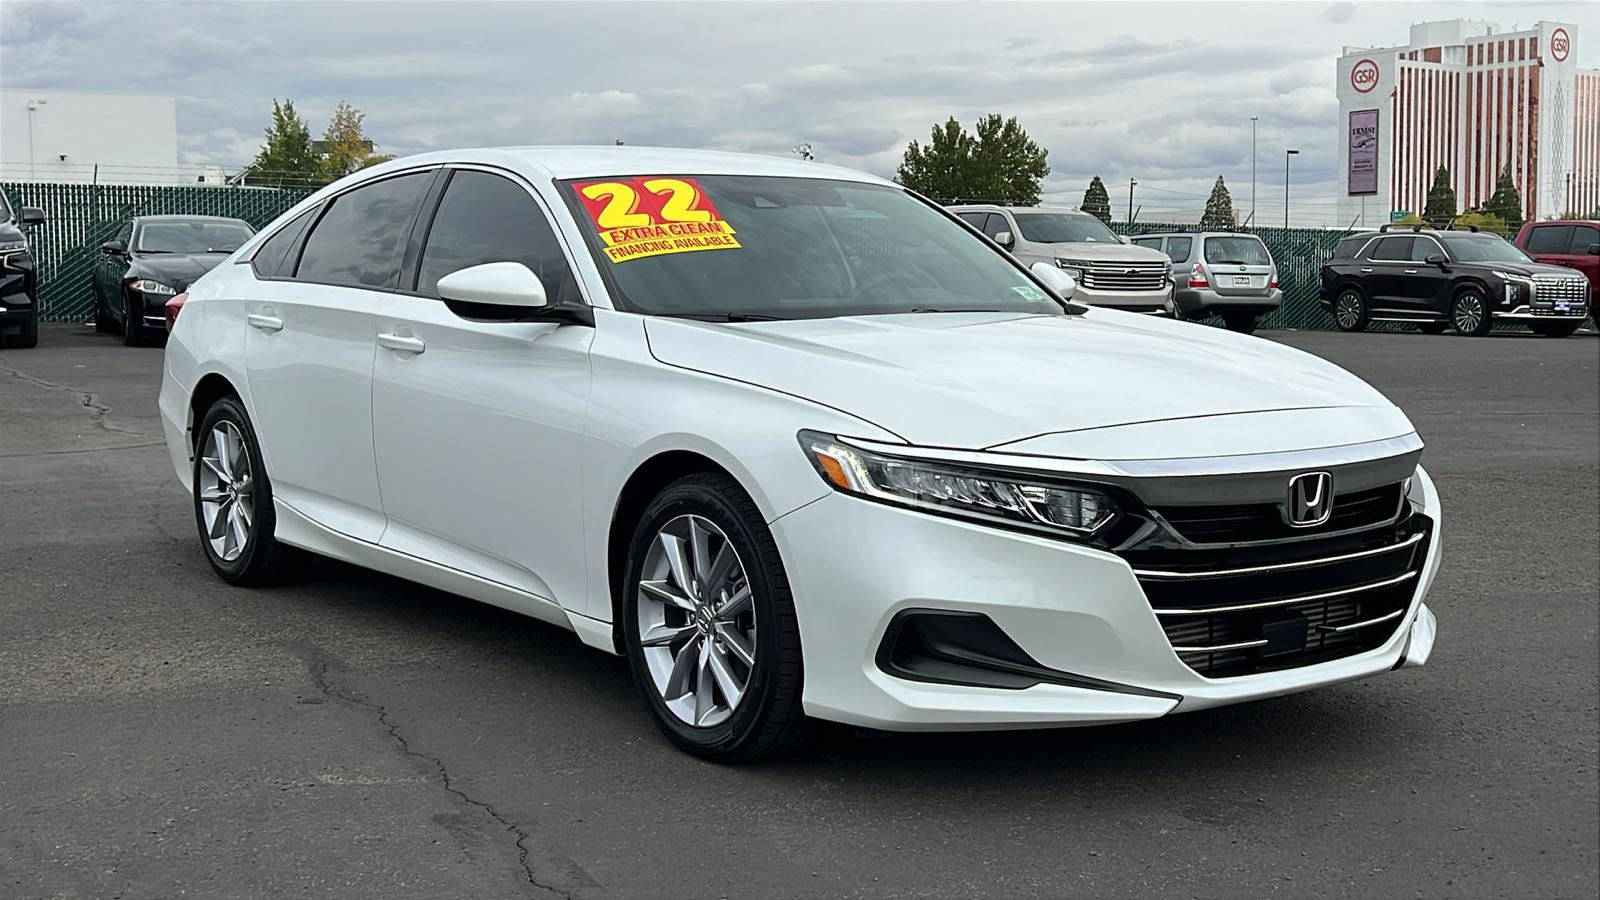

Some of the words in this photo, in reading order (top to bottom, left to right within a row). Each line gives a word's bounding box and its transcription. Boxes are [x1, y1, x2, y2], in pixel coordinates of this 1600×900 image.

[1354, 68, 1375, 84] GSR
[581, 179, 715, 229] 22
[609, 226, 668, 244] EXTRA
[668, 221, 724, 236] CLEAN
[608, 240, 673, 260] FINANCING
[675, 235, 735, 250] AVAILABLE
